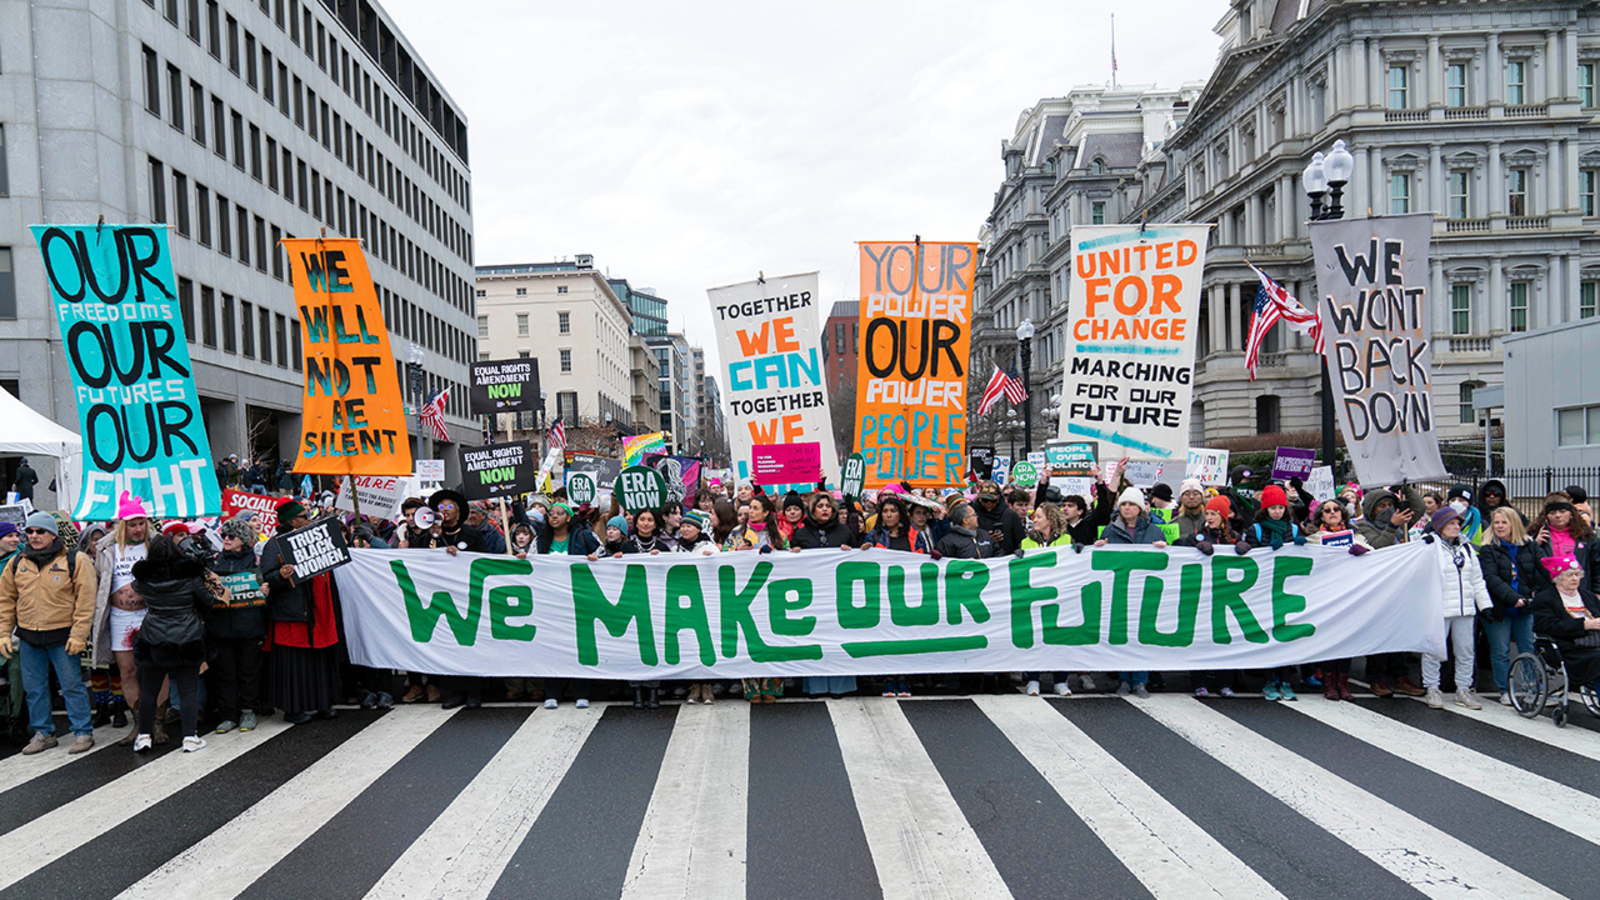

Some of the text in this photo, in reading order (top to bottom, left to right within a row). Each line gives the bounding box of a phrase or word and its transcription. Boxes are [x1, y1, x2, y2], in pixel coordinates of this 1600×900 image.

[41, 227, 176, 304] OUR
[300, 250, 354, 293] WE
[864, 244, 972, 296] YOUR
[1077, 239, 1198, 279] UNITED
[1334, 236, 1404, 286] WE
[716, 291, 811, 320] TOGETHER
[866, 292, 967, 324] POWER
[1085, 274, 1182, 317] FOR
[58, 303, 173, 321] FREEDOMS
[1326, 286, 1425, 335] WONT
[735, 316, 800, 357] WE
[1073, 318, 1187, 341] CHANGE
[67, 321, 190, 388] OUR
[865, 317, 964, 381] OUR
[306, 356, 381, 397] NOT
[474, 363, 531, 377] EQUAL RIGHTS
[476, 372, 531, 386] AMENDMENT
[728, 347, 821, 391] CAN
[1070, 357, 1191, 385] MARCHING
[1335, 336, 1429, 395] BACK
[77, 380, 185, 404] FUTURES
[487, 383, 522, 399] NOW
[730, 391, 824, 416] TOGETHER
[866, 377, 963, 410] POWER
[1076, 383, 1176, 406] FOR OUR
[332, 398, 369, 430] BE
[1070, 403, 1182, 428] FUTURE
[1343, 391, 1432, 441] DOWN
[86, 400, 198, 473] OUR
[303, 429, 397, 458] SILENT
[747, 414, 804, 445] WE
[860, 410, 963, 450] PEOPLE
[464, 446, 523, 463] EQUAL RIGHTS
[1049, 445, 1093, 453] PEOPLE
[466, 455, 523, 472] AMENDMENT
[480, 466, 516, 485] NOW
[845, 458, 862, 479] ERA
[861, 447, 962, 484] POWER
[1015, 472, 1036, 481] NOW
[1017, 464, 1033, 473] ERA
[572, 477, 591, 490] ERA
[573, 490, 591, 501] NOW
[621, 471, 659, 492] ERA
[842, 480, 861, 497] NOW
[624, 491, 660, 510] NOW
[287, 523, 329, 550] TRUST
[292, 536, 336, 564] BLACK
[294, 547, 348, 579] WOMEN.
[219, 574, 256, 584] EOPLE
[226, 583, 251, 592] VER
[836, 560, 991, 630] OUR
[1009, 550, 1316, 649] FUTURE
